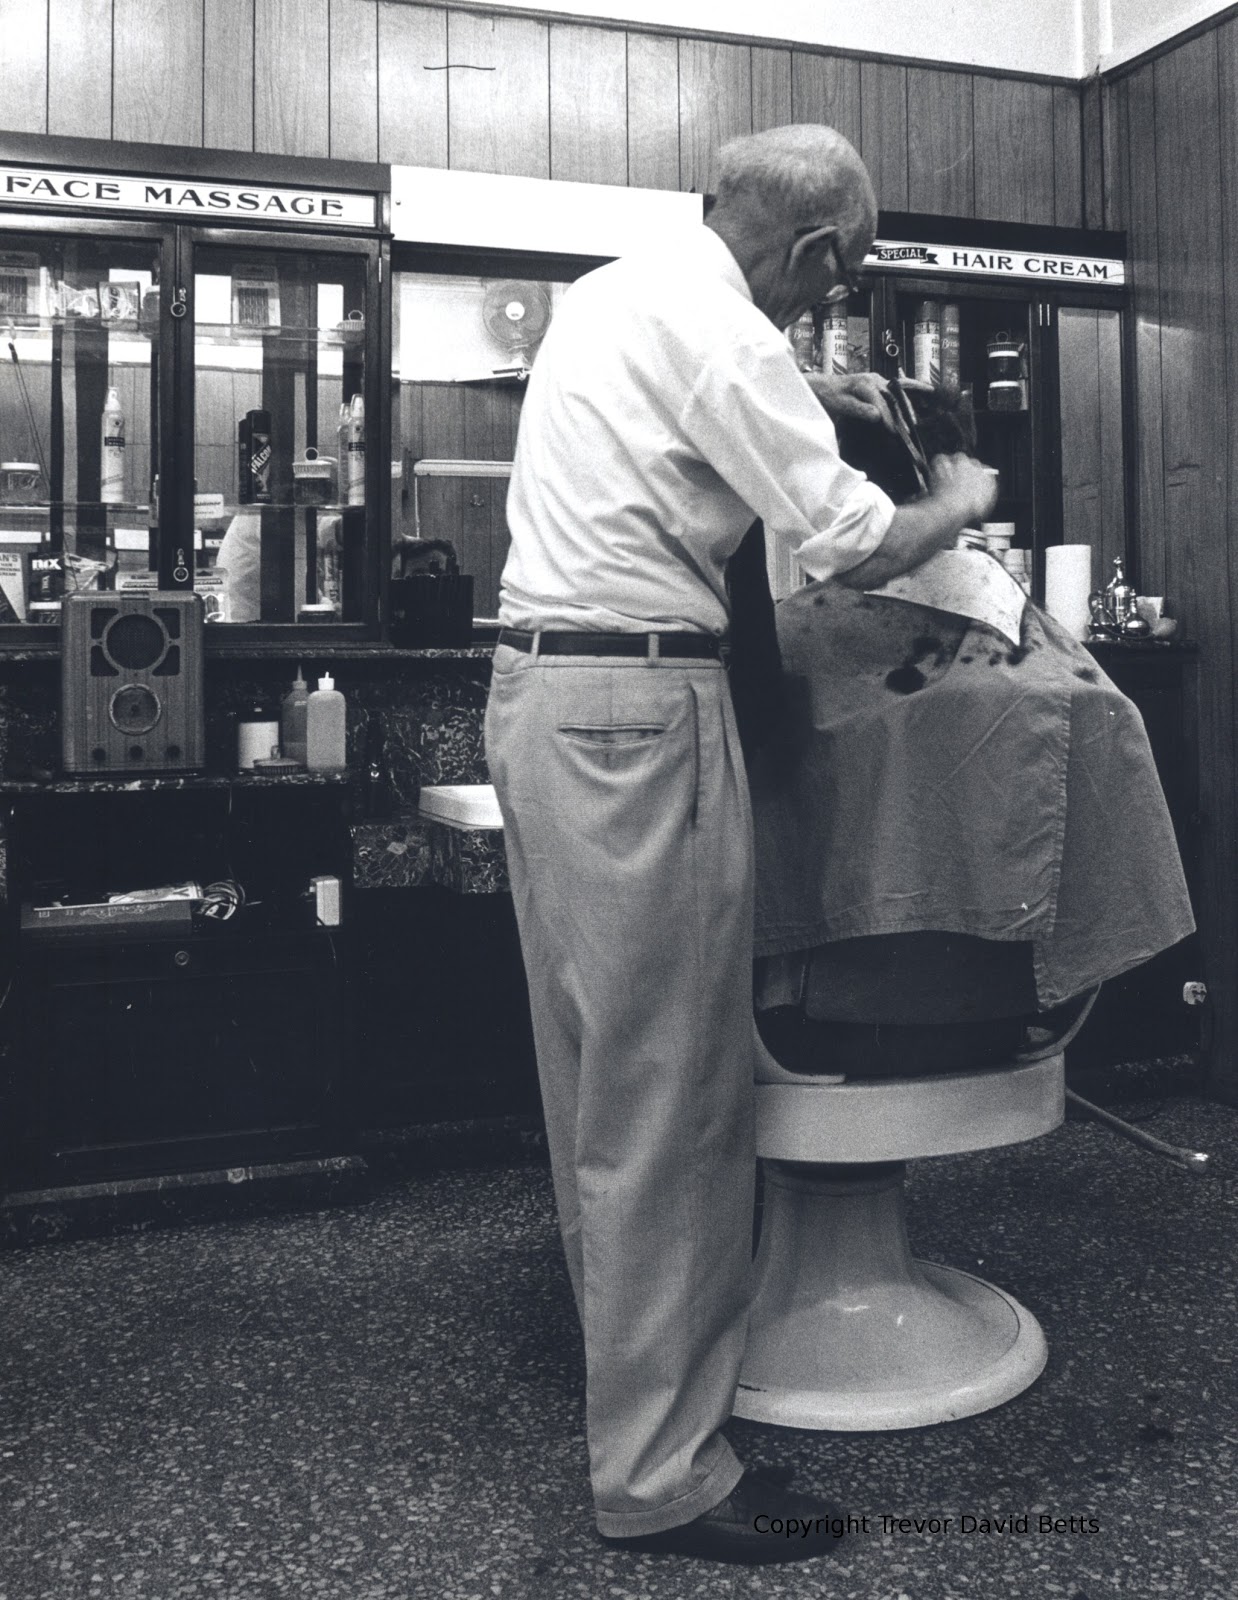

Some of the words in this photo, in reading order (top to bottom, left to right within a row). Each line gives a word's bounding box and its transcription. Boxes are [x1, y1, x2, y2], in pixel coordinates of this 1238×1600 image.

[6, 175, 121, 201] FACE
[145, 186, 344, 218] MASSAGE
[880, 249, 924, 260] SPECIAL
[952, 252, 1013, 271] HAIR
[1023, 258, 1109, 280] CREAM
